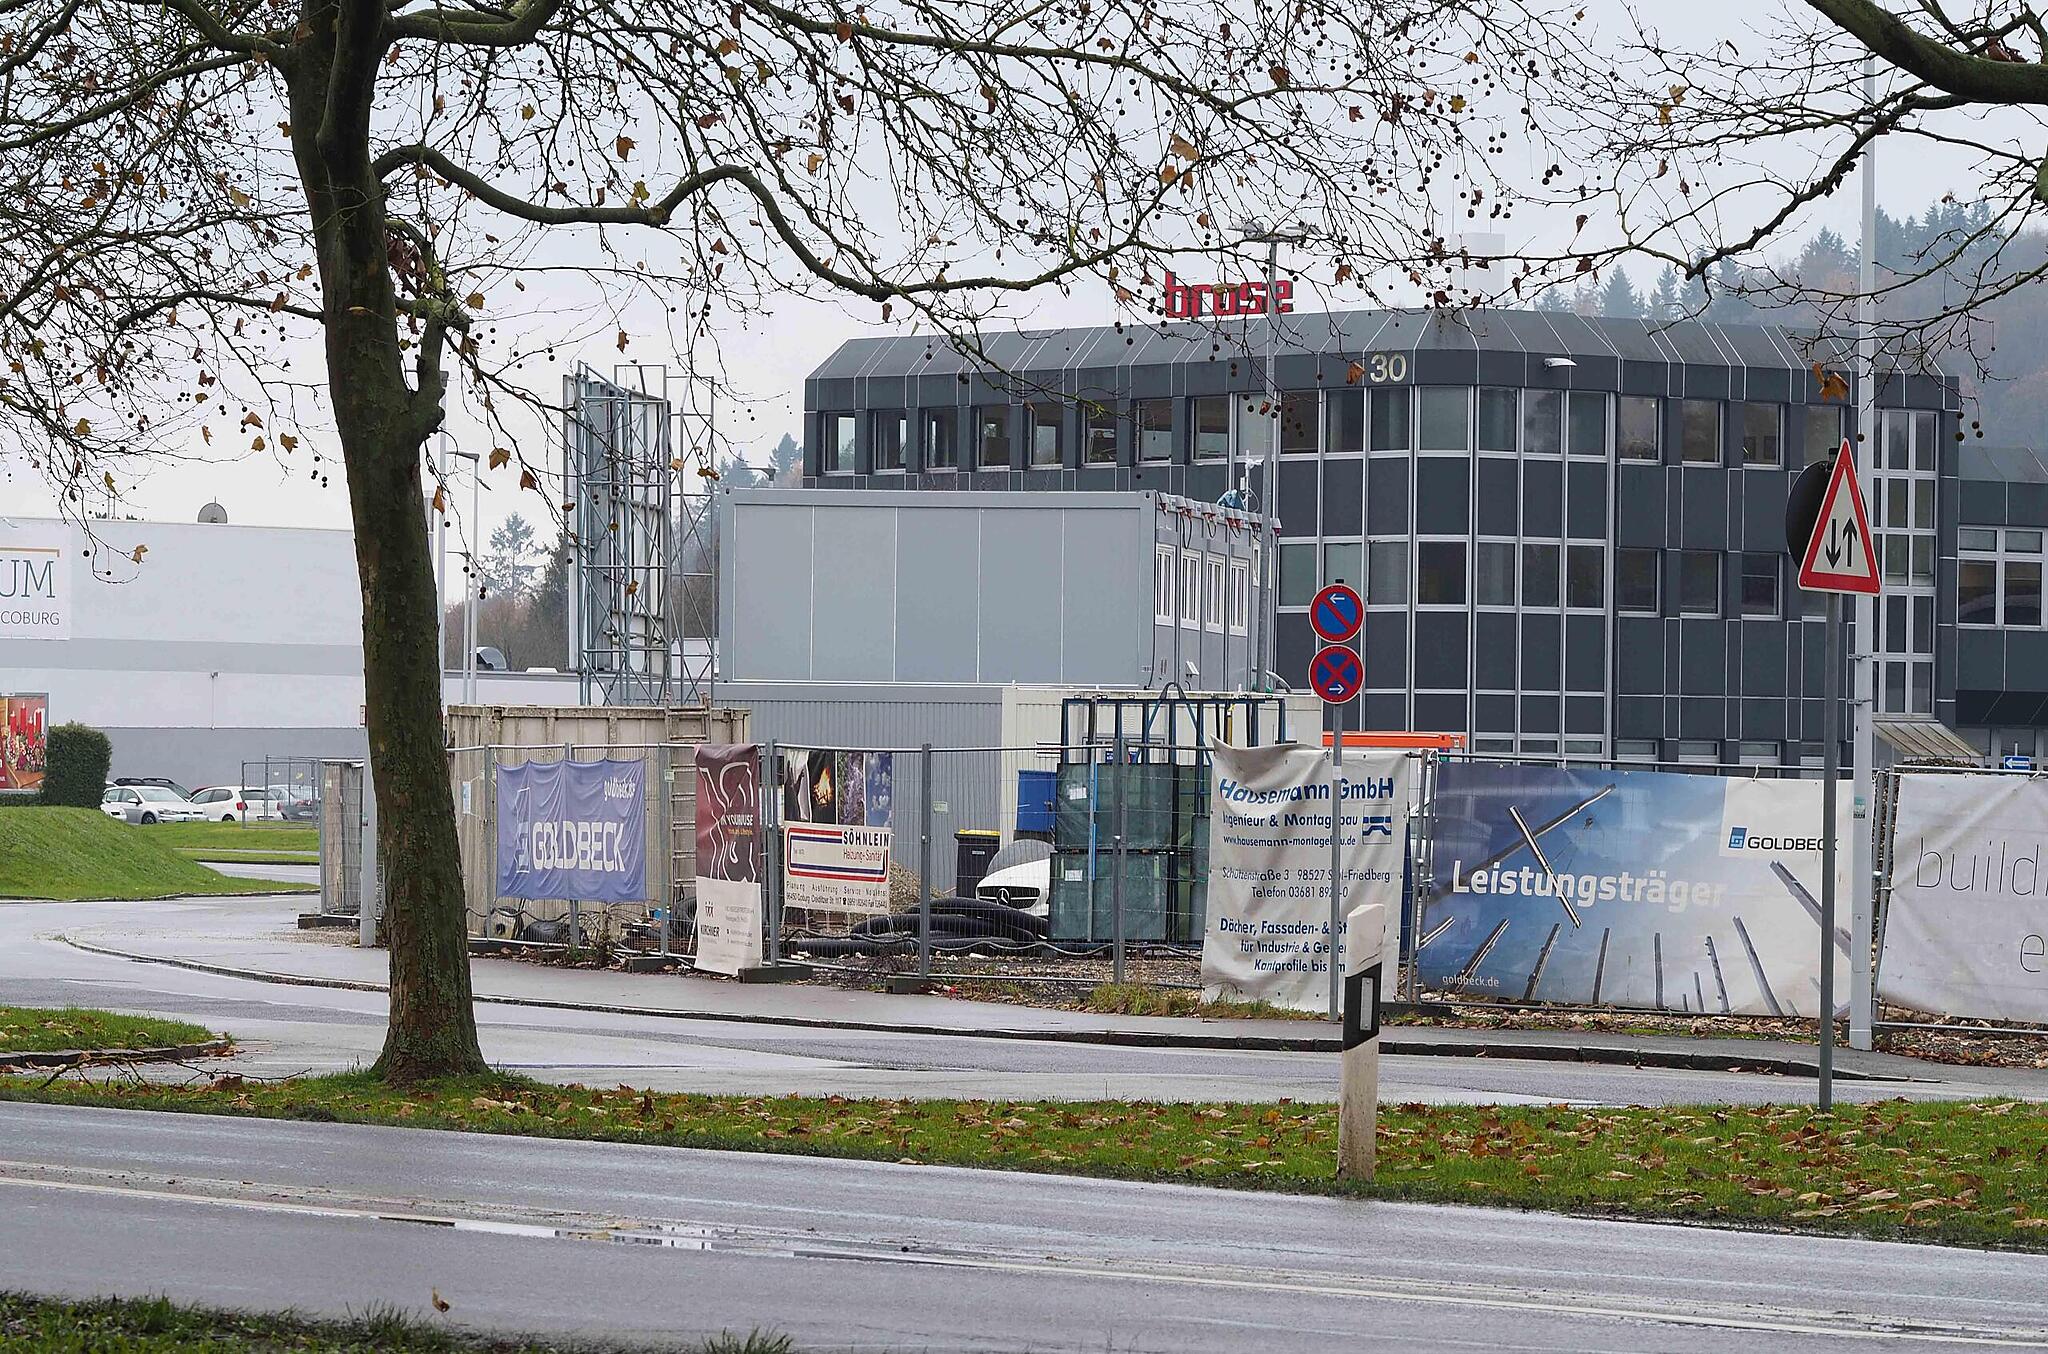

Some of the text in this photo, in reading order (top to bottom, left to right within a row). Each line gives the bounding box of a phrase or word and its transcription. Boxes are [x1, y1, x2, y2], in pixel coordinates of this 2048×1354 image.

[1165, 271, 1293, 318] brose
[1369, 354, 1407, 383] 30
[0, 610, 60, 625] COBURG
[1219, 777, 1394, 804] Hausemann GmbH
[1269, 814, 1279, 827] &
[1284, 813, 1358, 829] Montagbau
[843, 828, 890, 847] SÖHNLEIN
[1223, 835, 1356, 848] www.hausemann-montageu.de
[532, 820, 626, 872] GOLDBECK
[1916, 837, 2048, 896] build
[1284, 868, 1290, 881] 3
[1297, 869, 1325, 881] 98527
[1328, 868, 1391, 883] Sl-Friedberg
[843, 886, 861, 896] Service
[1251, 887, 1286, 898] Telefon
[1288, 886, 1315, 898] 03681
[1452, 860, 1728, 913] Leistungsträger
[1220, 918, 1258, 935] Dächer,
[1261, 920, 1319, 935] Fassaden-
[1240, 941, 1254, 953] für
[1258, 941, 1300, 954] Industrie
[1302, 942, 1310, 953] &
[1311, 959, 1328, 972] bis
[1442, 975, 1500, 987] goldbeck.de
